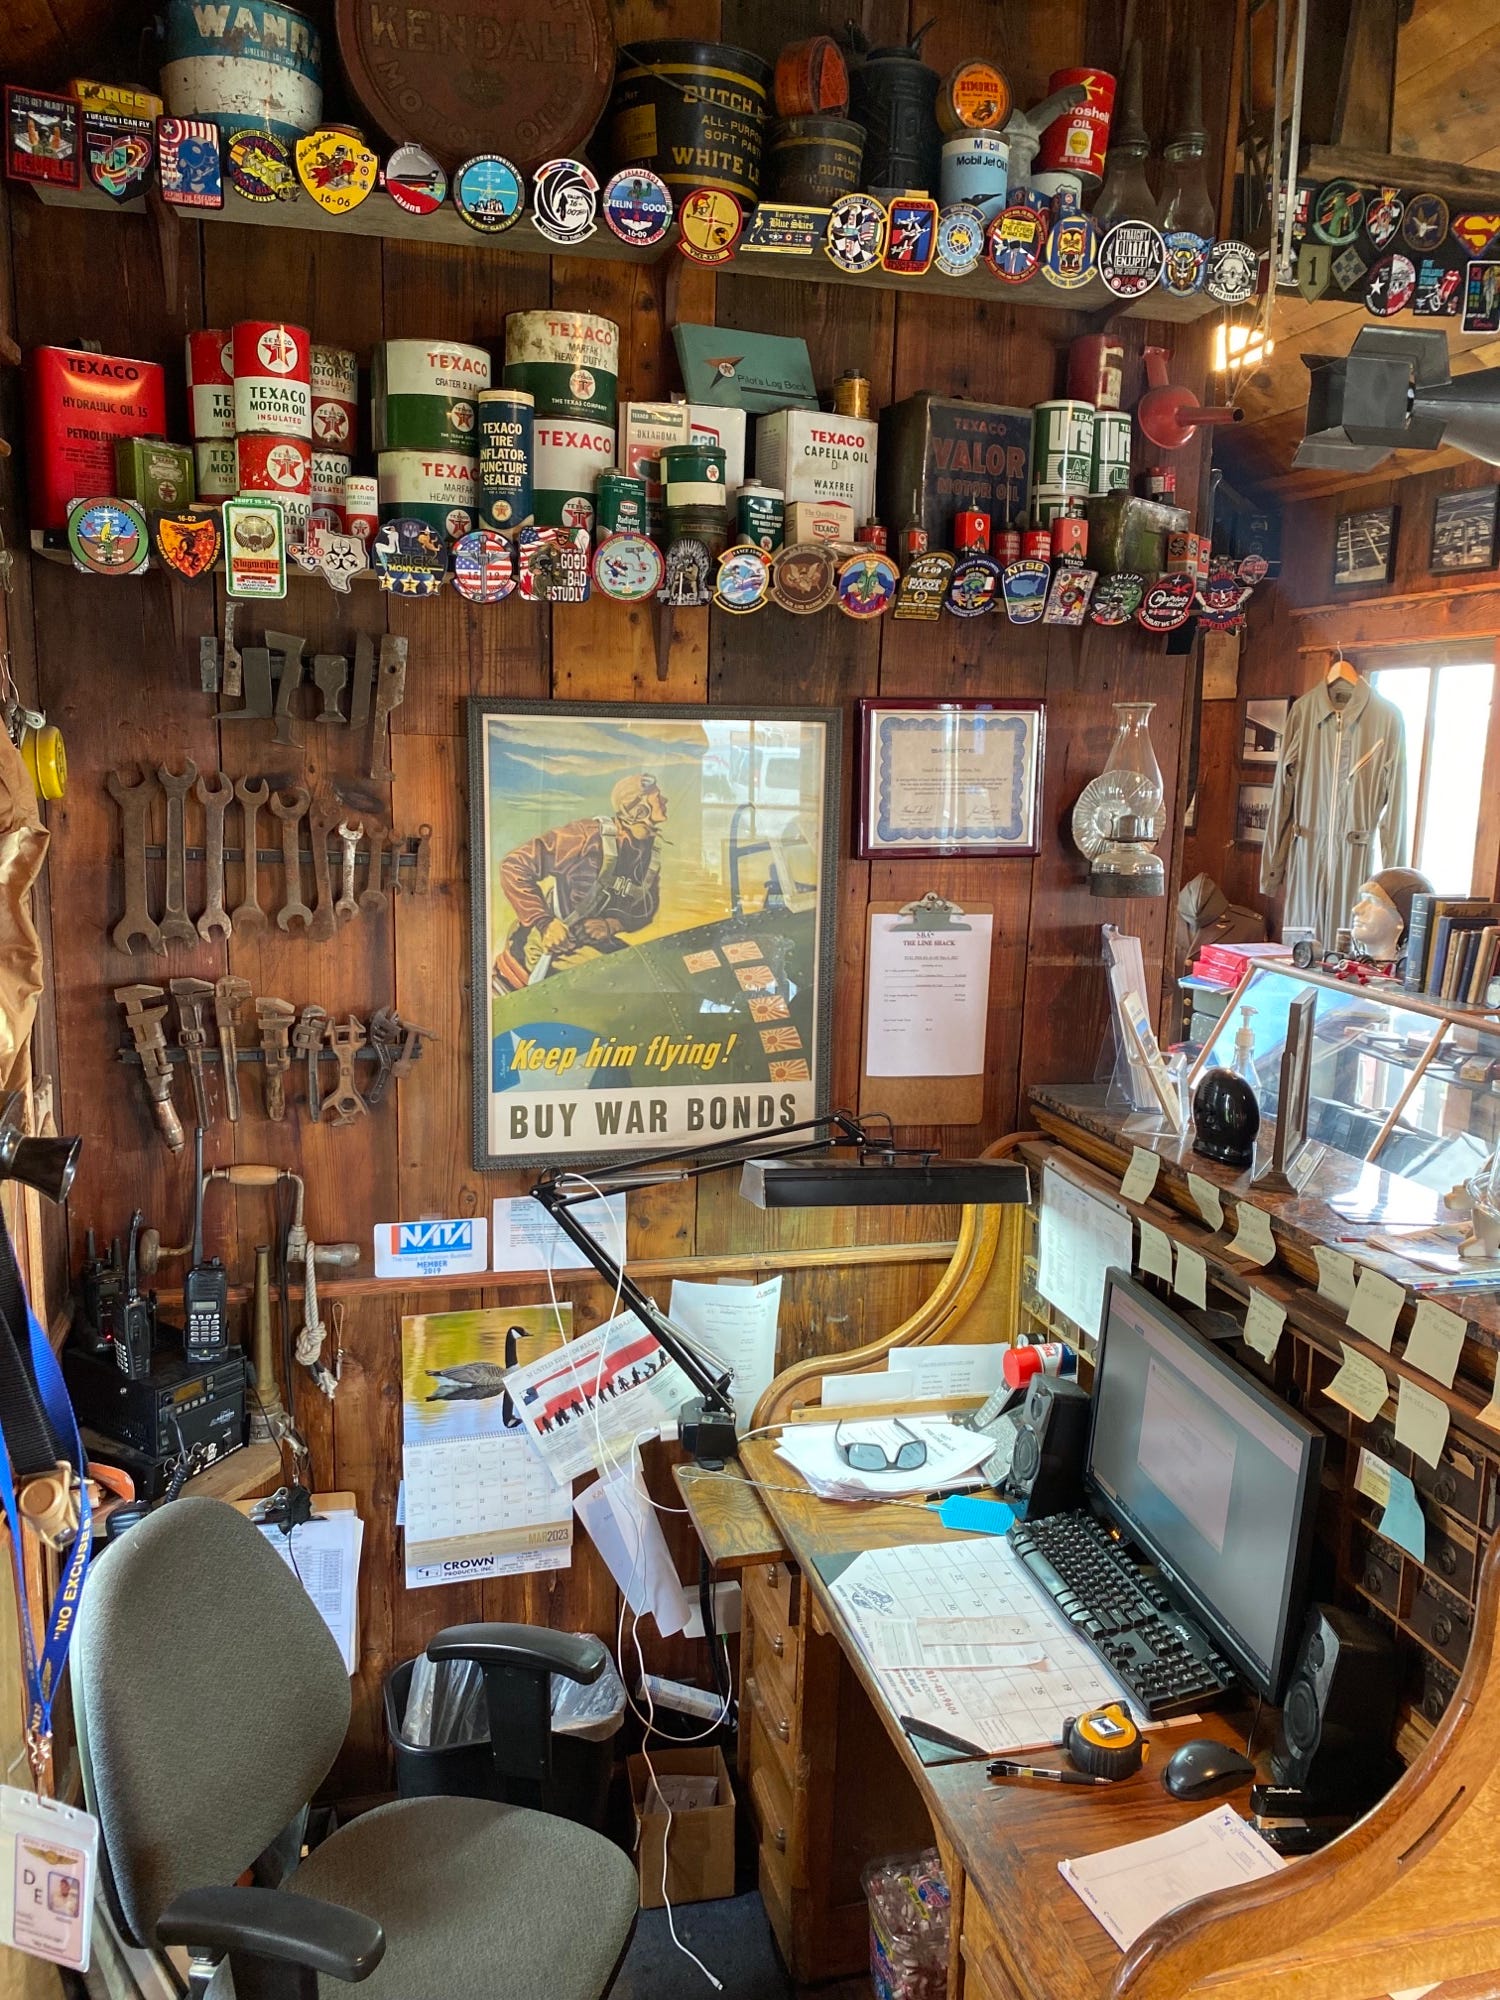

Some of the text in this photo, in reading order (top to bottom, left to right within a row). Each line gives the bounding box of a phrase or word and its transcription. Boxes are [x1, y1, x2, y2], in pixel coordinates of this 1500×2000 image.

[370, 3, 591, 64] KENDALL
[683, 84, 752, 114] DUTCH
[123, 118, 137, 127] CAN
[139, 119, 150, 128] FLY
[1073, 119, 1091, 129] OIL
[704, 129, 737, 145] SOFT
[672, 147, 744, 176] WHITE
[956, 156, 982, 167] Mobil
[983, 157, 996, 167] Jet
[319, 193, 351, 207] 16-06
[604, 199, 667, 213] FEELIN GOOD
[769, 217, 815, 230] Blue Skies
[627, 229, 648, 238] 16-09
[1118, 229, 1150, 240] STRAIGHT
[1117, 240, 1149, 257] OUTTA
[1115, 256, 1147, 267] ENJJPT
[1308, 257, 1318, 286] 1
[547, 321, 612, 346] TEXACO
[66, 357, 139, 381] TEXACO
[427, 352, 488, 378] TEXACO
[435, 377, 460, 389] CRATER
[765, 379, 783, 390] Log
[250, 386, 306, 404] TEXACO
[62, 396, 148, 418] HYDRAULIC OIL 15
[250, 400, 306, 417] MOTOR OIL
[564, 399, 582, 407] TEXAS
[257, 414, 302, 425] INSULATED
[954, 417, 1007, 436] TEXACO
[483, 422, 523, 434] TEXACO
[489, 435, 514, 447] TIRE
[538, 429, 612, 454] TEXACO
[637, 429, 677, 442] OKLAHOMA
[811, 430, 865, 448] TEXACO
[804, 445, 869, 464] CAPELLA OIL
[932, 437, 1026, 478] VALOR
[422, 462, 479, 482] TEXAC
[479, 461, 528, 475] PUNCTURE
[483, 474, 521, 487] SEALER
[813, 479, 855, 492] WAXFREE
[347, 484, 375, 492] TEXACO
[936, 477, 1020, 502] MOTOR OIL
[430, 491, 456, 502] HEAVY
[617, 514, 640, 525] Radiator
[814, 523, 840, 534] TEXACO
[388, 564, 432, 574] MONKEYS
[561, 554, 588, 570] GOOD
[1007, 562, 1044, 575] NTSB
[1065, 558, 1084, 566] TEXACO
[917, 566, 942, 574] 15-09
[567, 571, 587, 586] BAD
[1110, 573, 1144, 583] ENJJPT
[552, 586, 585, 602] STUDLY
[510, 1032, 738, 1076] Keep him flying!
[510, 1092, 797, 1140] BUY WAR BONDS
[401, 1221, 471, 1249] NATA
[417, 1260, 448, 1268] MEMBER
[547, 1529, 569, 1543] 2023
[443, 1556, 494, 1571] CROWN
[23, 1868, 36, 1886] D
[34, 1888, 43, 1905] E
